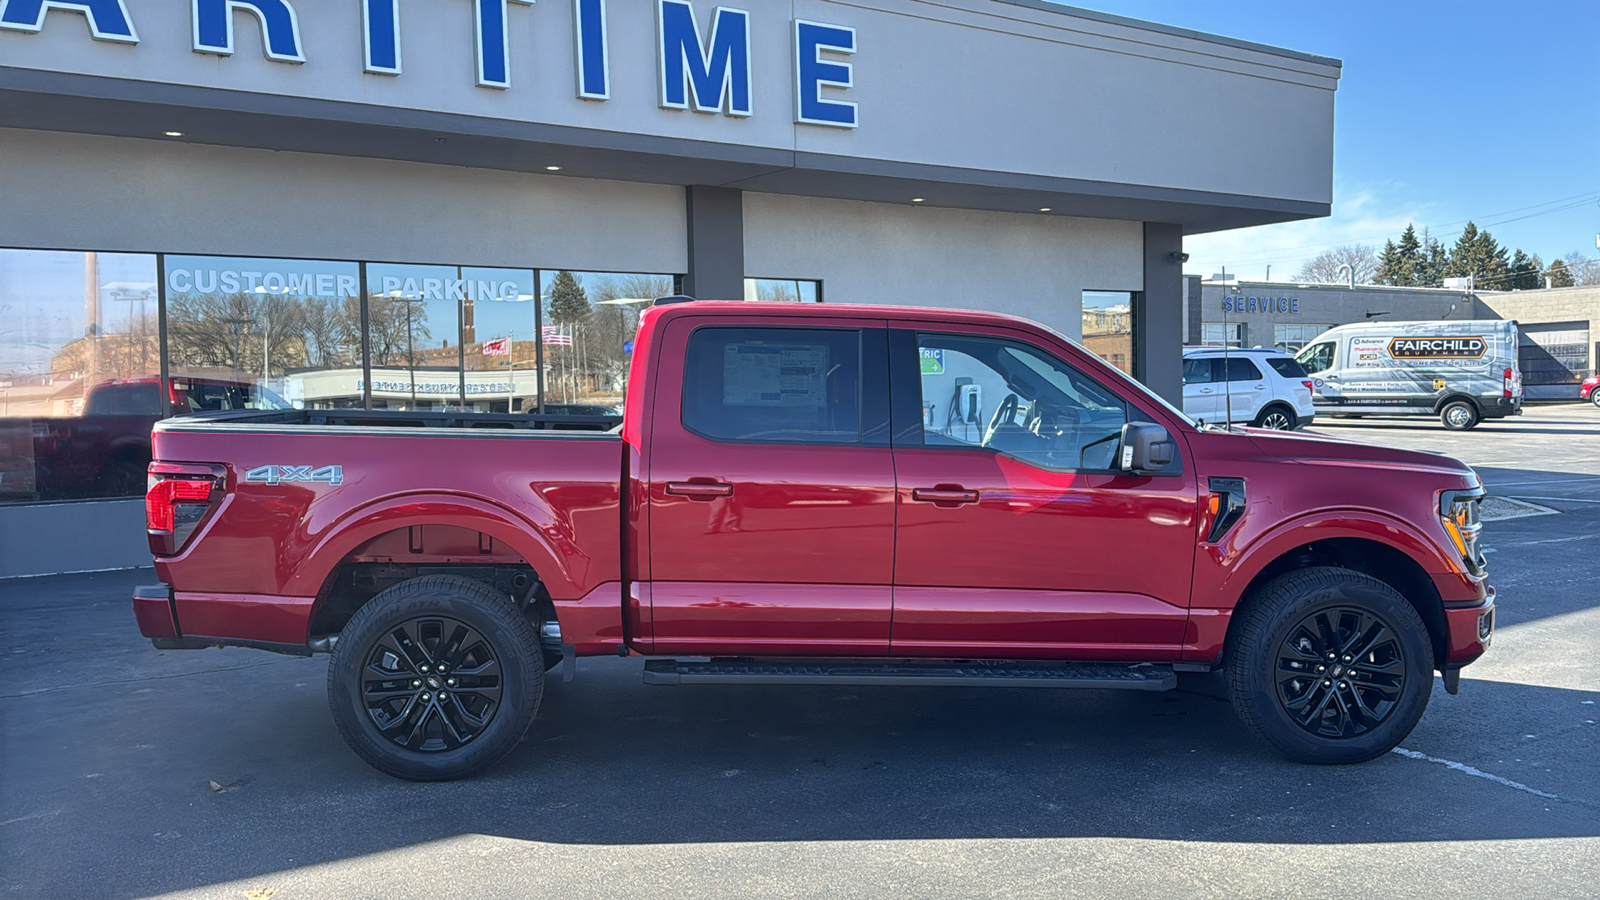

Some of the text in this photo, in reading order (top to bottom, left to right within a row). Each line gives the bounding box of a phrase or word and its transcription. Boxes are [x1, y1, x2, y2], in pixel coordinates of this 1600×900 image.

[169, 268, 519, 303] CUSTOMER PARKING
[1224, 296, 1300, 314] SERVICE
[1394, 340, 1482, 351] FAIRCHILD
